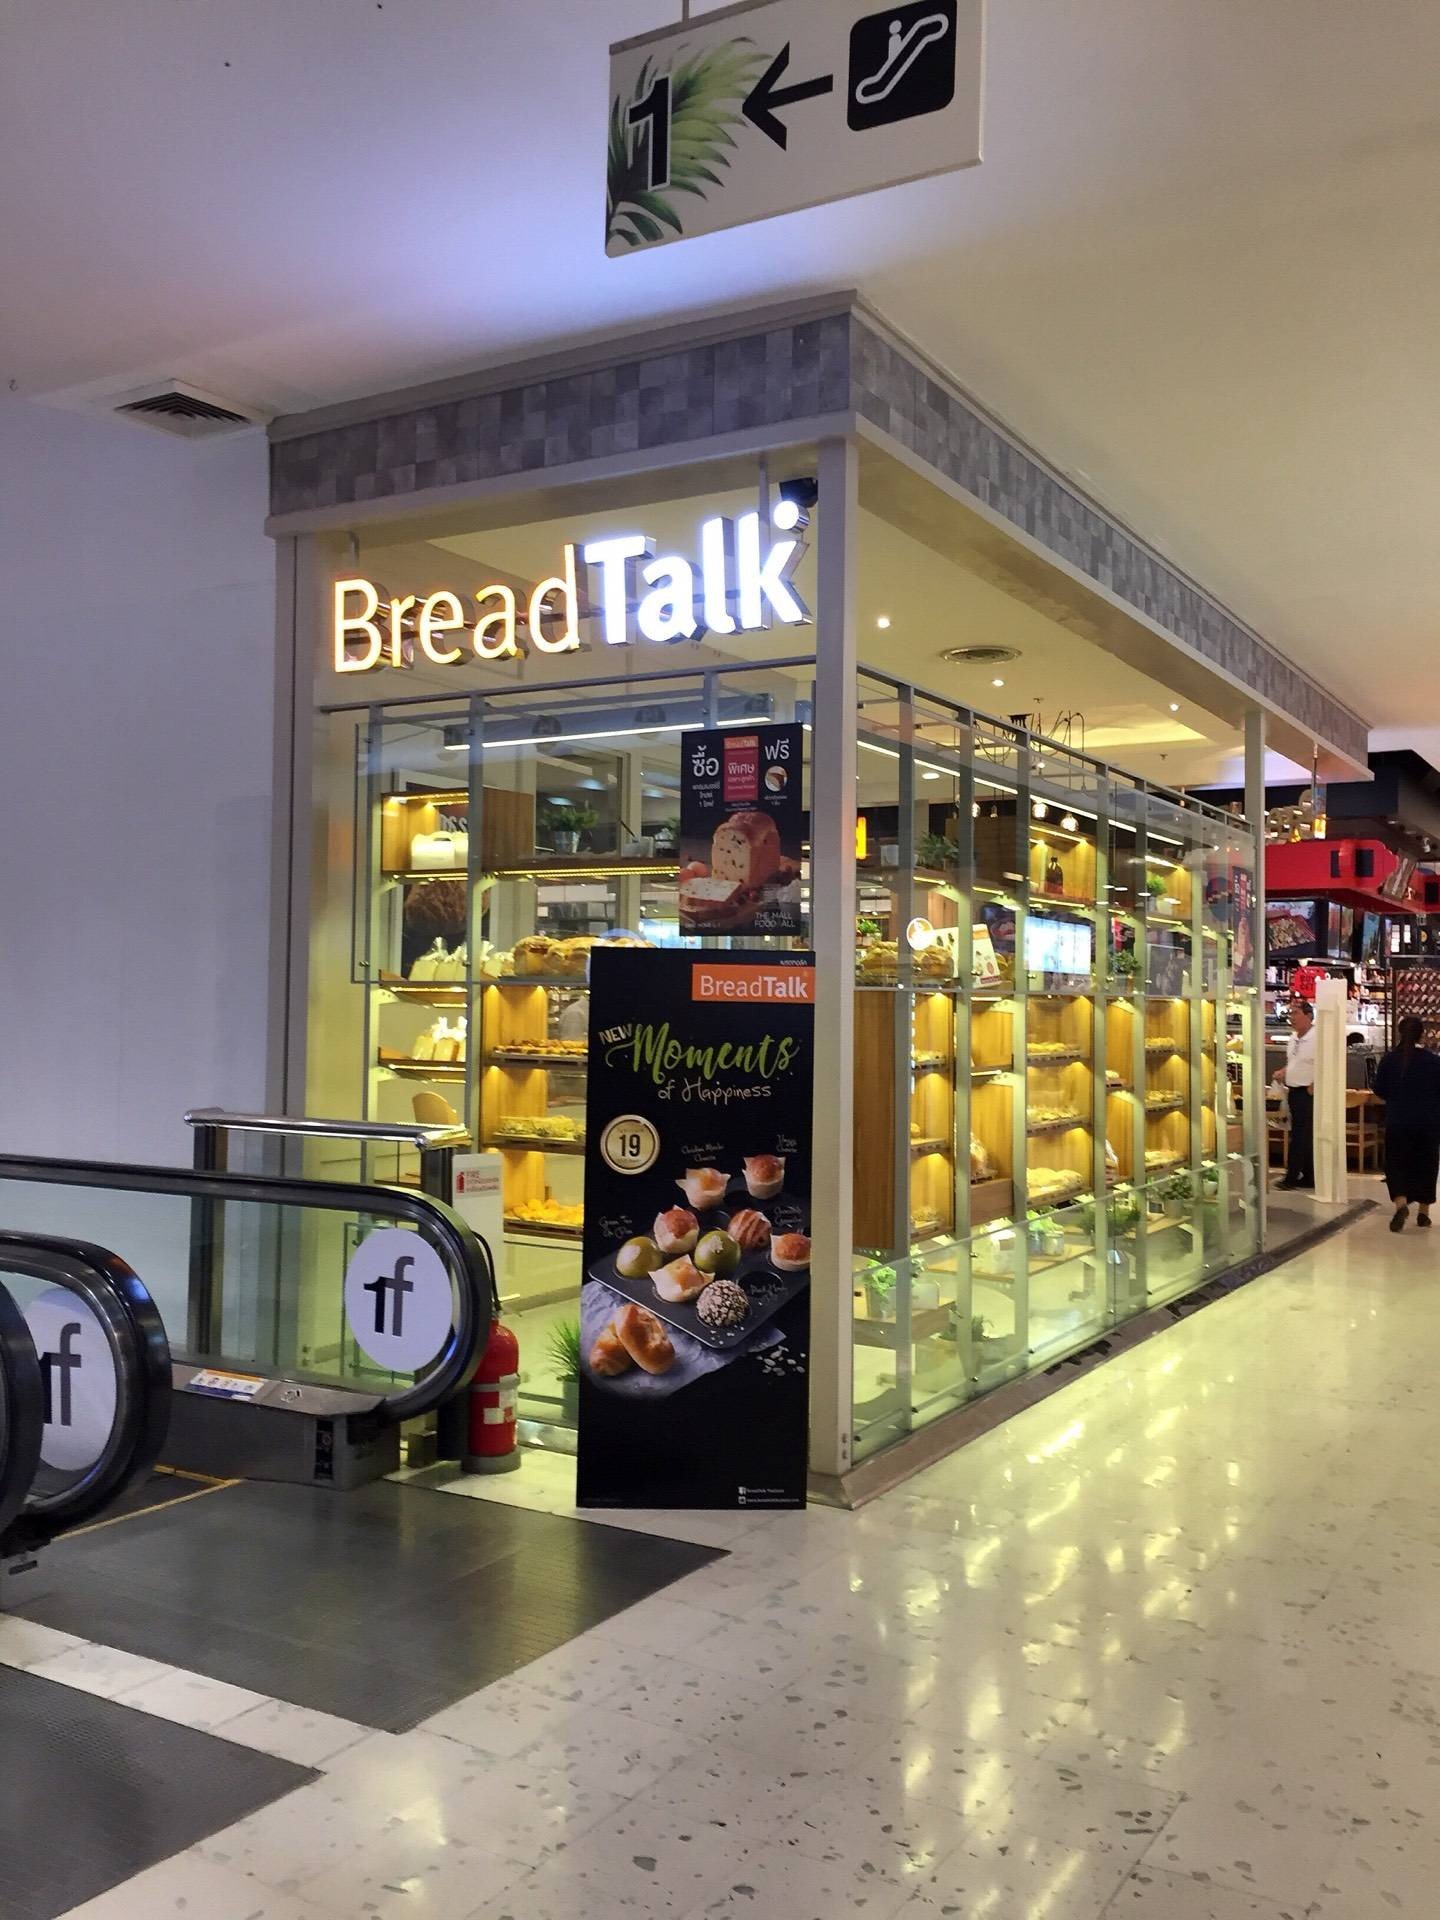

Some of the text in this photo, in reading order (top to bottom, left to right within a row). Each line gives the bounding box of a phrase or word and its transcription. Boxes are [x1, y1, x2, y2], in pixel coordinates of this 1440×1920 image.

[628, 74, 672, 188] 1
[334, 511, 806, 673] BreadTalk
[692, 745, 719, 777] ซื้อ
[764, 738, 789, 760] ฟรี
[700, 975, 808, 998] BreadTalk
[599, 1023, 632, 1045] NEW
[606, 1022, 800, 1084] Moments
[658, 1076, 772, 1105] of Happiness
[618, 1133, 641, 1157] 19
